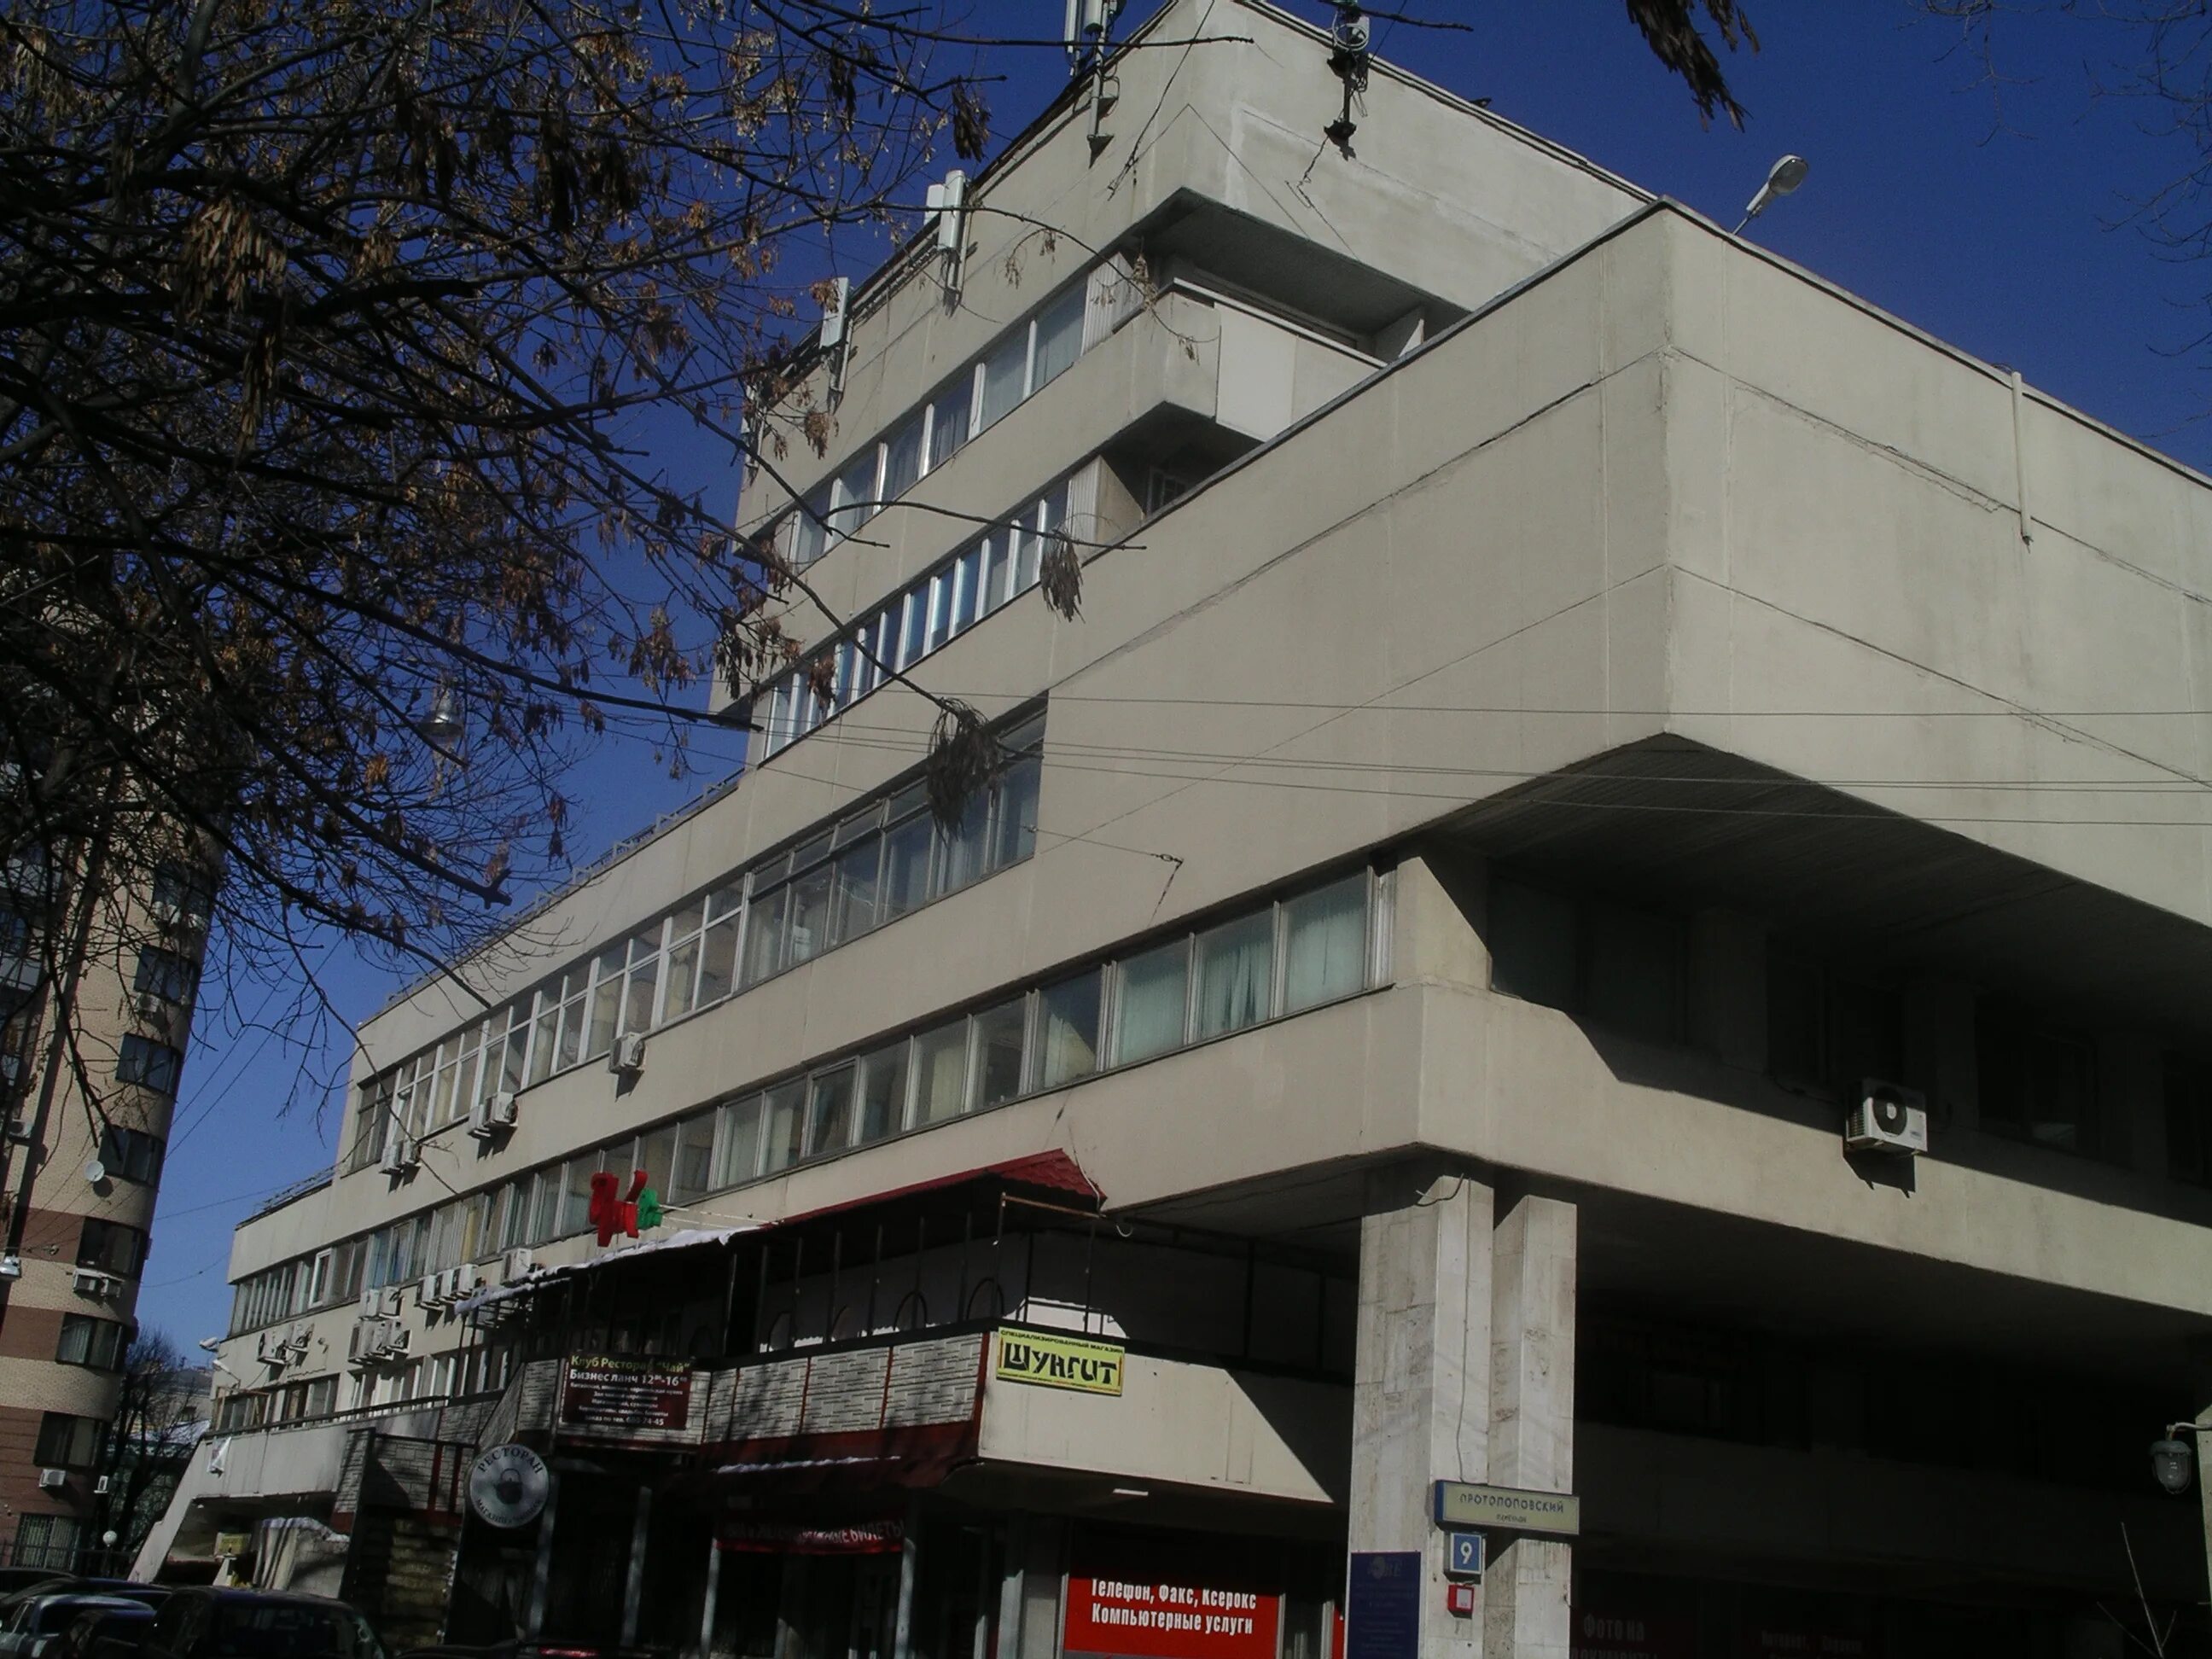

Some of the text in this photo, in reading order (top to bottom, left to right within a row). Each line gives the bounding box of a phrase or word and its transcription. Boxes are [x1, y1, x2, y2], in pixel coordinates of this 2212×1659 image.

[569, 1368, 609, 1382] Бизнес
[571, 1355, 599, 1369] Клуб
[1004, 1342, 1117, 1384] ШУНГИТ
[478, 1447, 544, 1474] РЕСТОРАН
[1459, 1493, 1564, 1513] ПРОТОПОПОВСКИЙ
[1460, 1541, 1473, 1564] 9
[1091, 1578, 1256, 1610] Телефон, Факс, Ксерокс
[1091, 1603, 1253, 1636] Компьютерные услуги
[1583, 1612, 1645, 1642] Фото на
